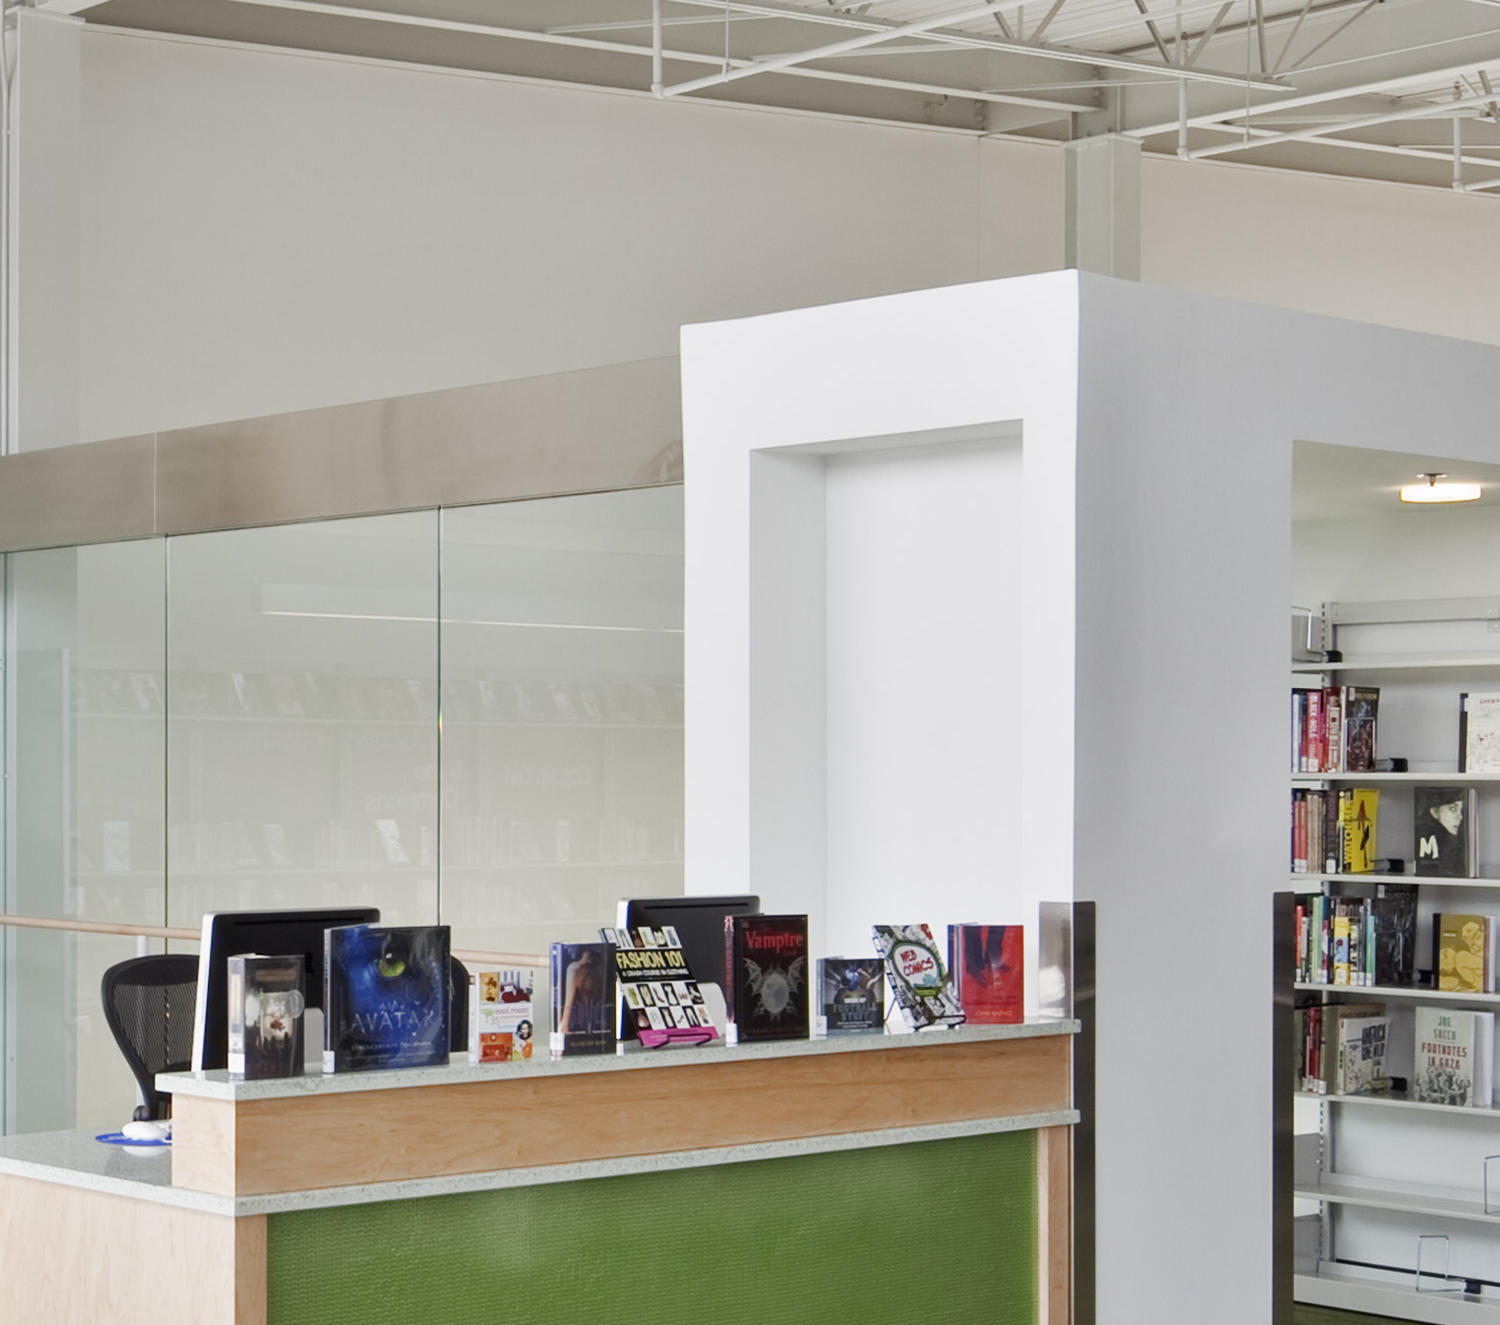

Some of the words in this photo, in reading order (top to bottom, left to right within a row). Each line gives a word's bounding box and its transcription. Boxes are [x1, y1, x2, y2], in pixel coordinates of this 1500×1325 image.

[1419, 835, 1439, 859] M
[616, 951, 667, 969] FASHION
[664, 950, 685, 967] 101
[351, 1010, 434, 1034] AVATAR
[1433, 1028, 1456, 1040] SACCO
[1421, 1042, 1467, 1058] FOOTNOTES
[1439, 1057, 1460, 1070] GAZA
